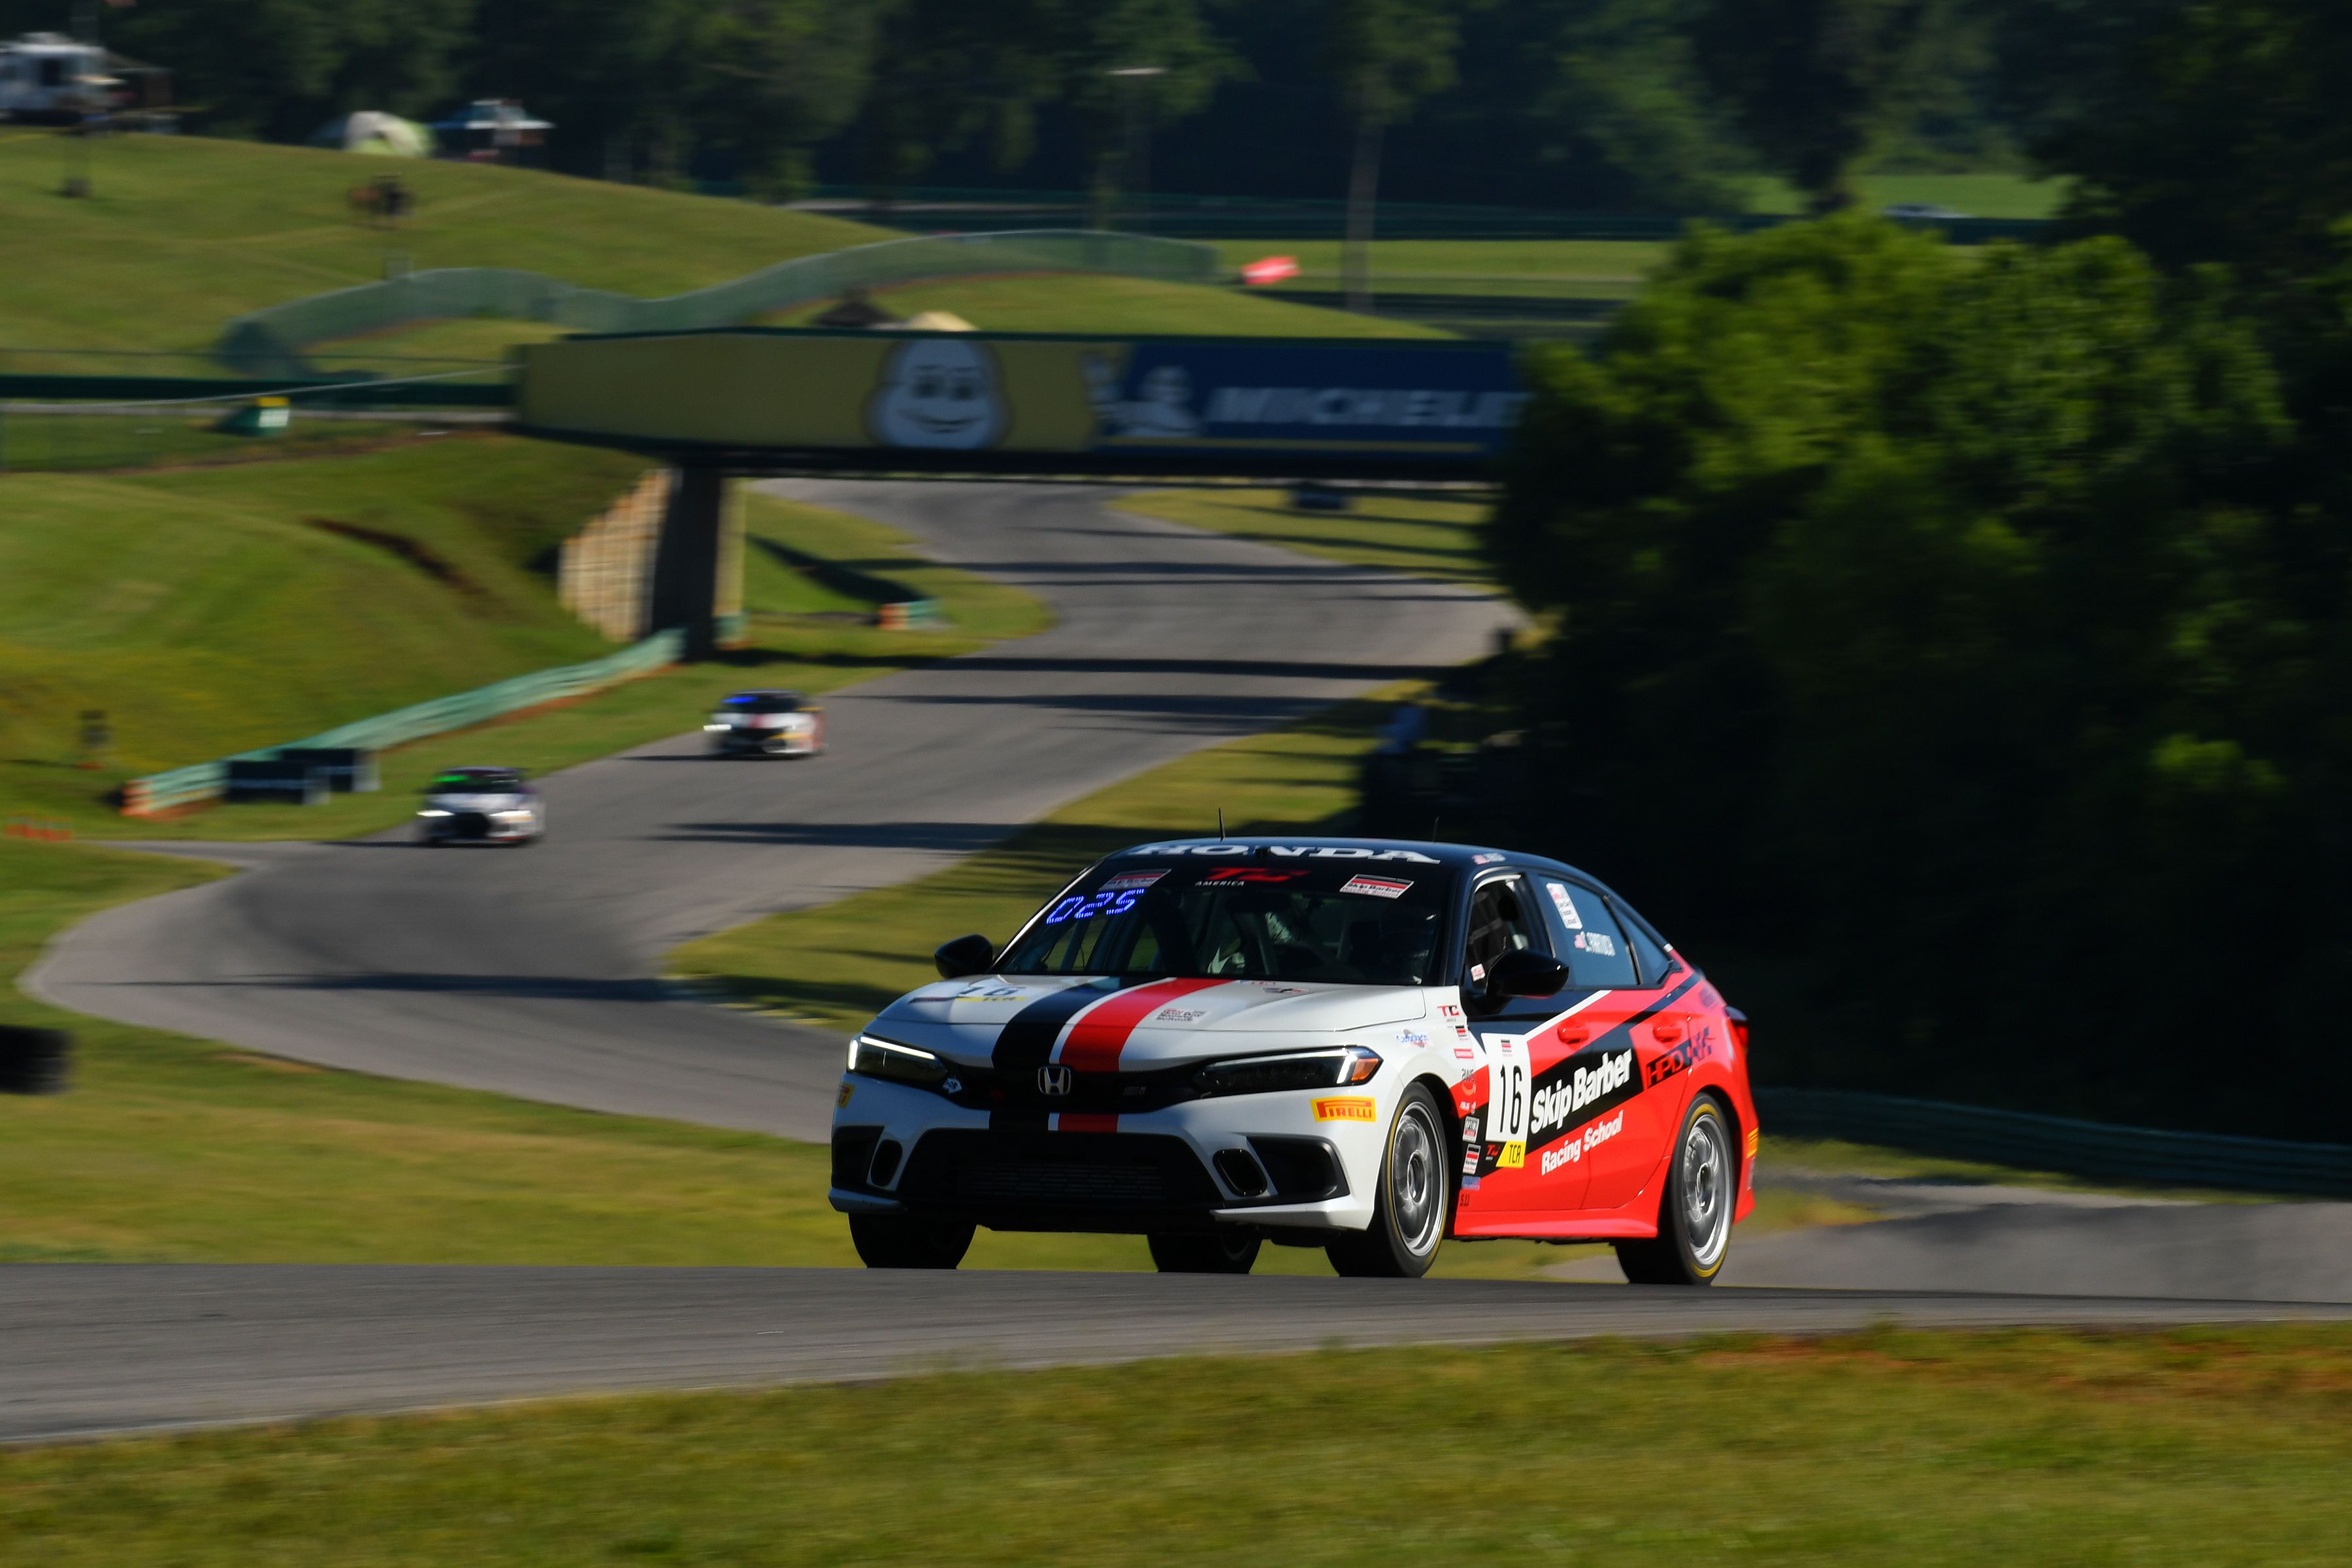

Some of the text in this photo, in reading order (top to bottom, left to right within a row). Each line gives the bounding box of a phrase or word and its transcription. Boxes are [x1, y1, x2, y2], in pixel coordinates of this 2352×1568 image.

[1127, 844, 1441, 864] HONDA
[1369, 885, 1402, 893] Barber
[1047, 888, 1145, 924] 025
[1437, 1005, 1460, 1017] TC
[1646, 1049, 1684, 1089] HPD
[1499, 1064, 1523, 1135] 16
[1531, 1048, 1632, 1134] Skip Barber
[1316, 1099, 1372, 1119] PIRELLI
[1509, 1144, 1521, 1164] TCA
[1541, 1109, 1624, 1176] Racing School
